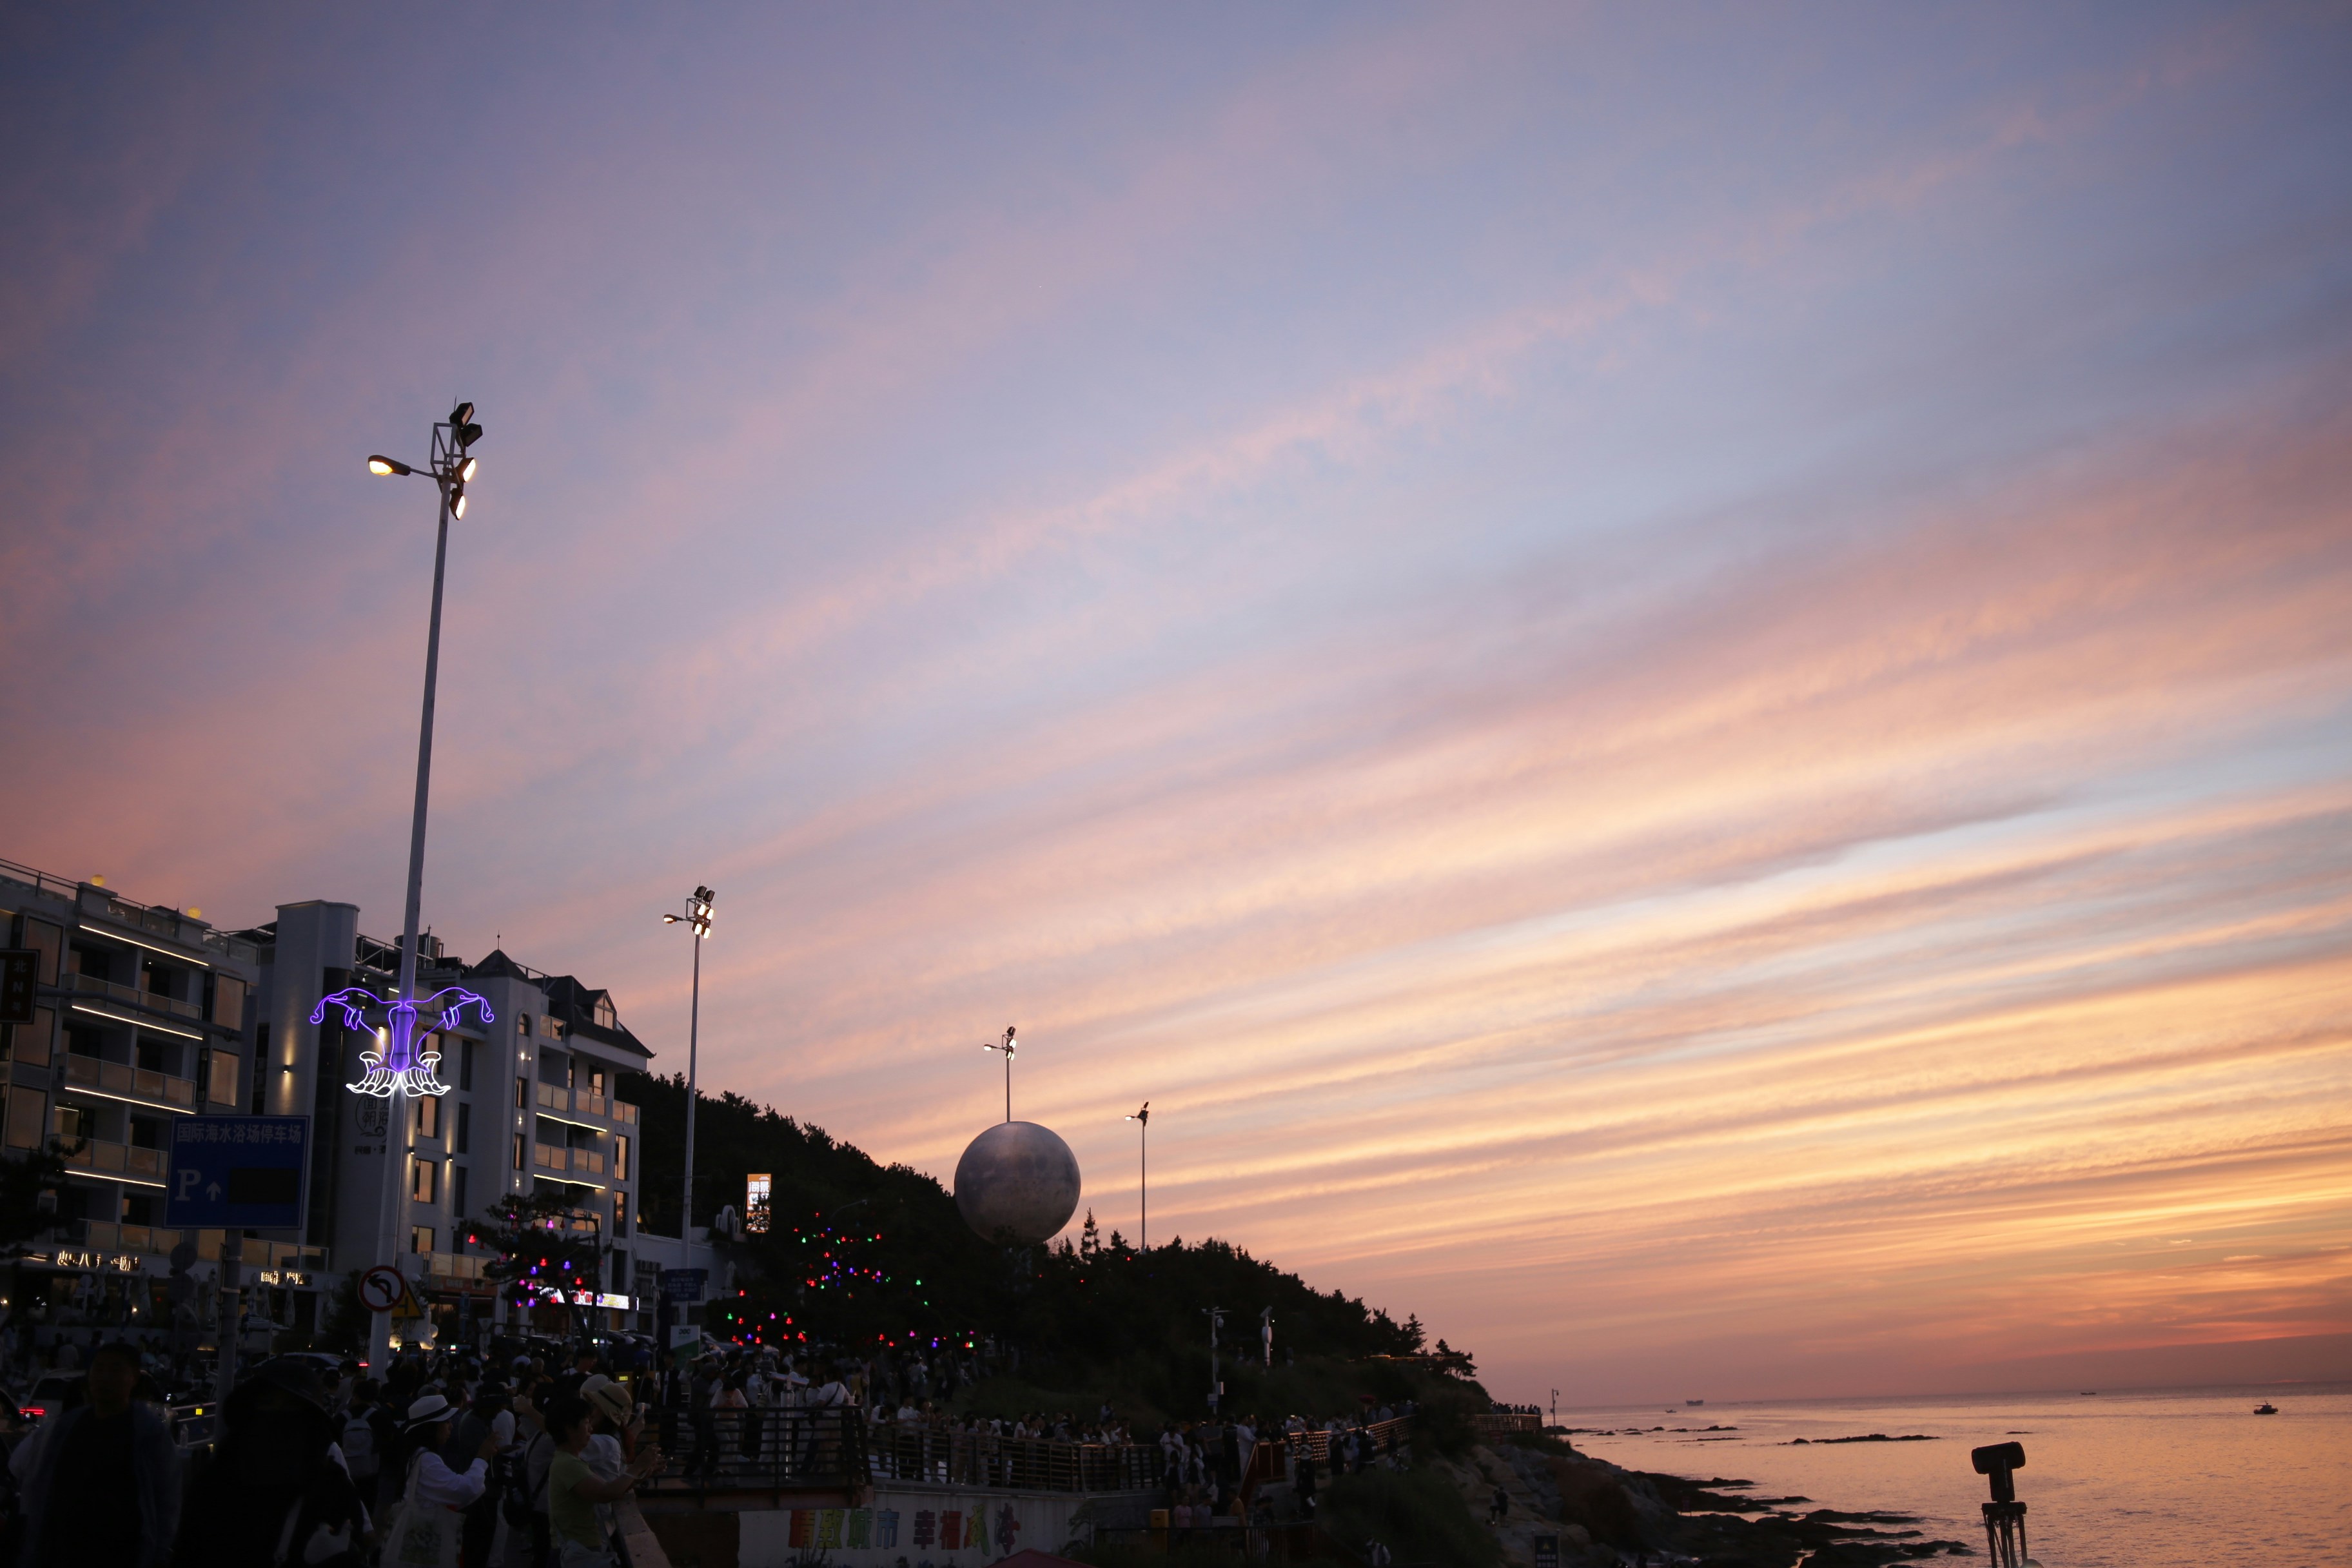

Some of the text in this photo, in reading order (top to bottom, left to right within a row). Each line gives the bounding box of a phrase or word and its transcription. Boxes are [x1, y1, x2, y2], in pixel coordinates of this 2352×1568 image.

[14, 960, 26, 972] 北
[12, 981, 23, 993] N
[176, 1122, 302, 1144] 国际海水浴场停车场
[175, 1168, 202, 1202] P
